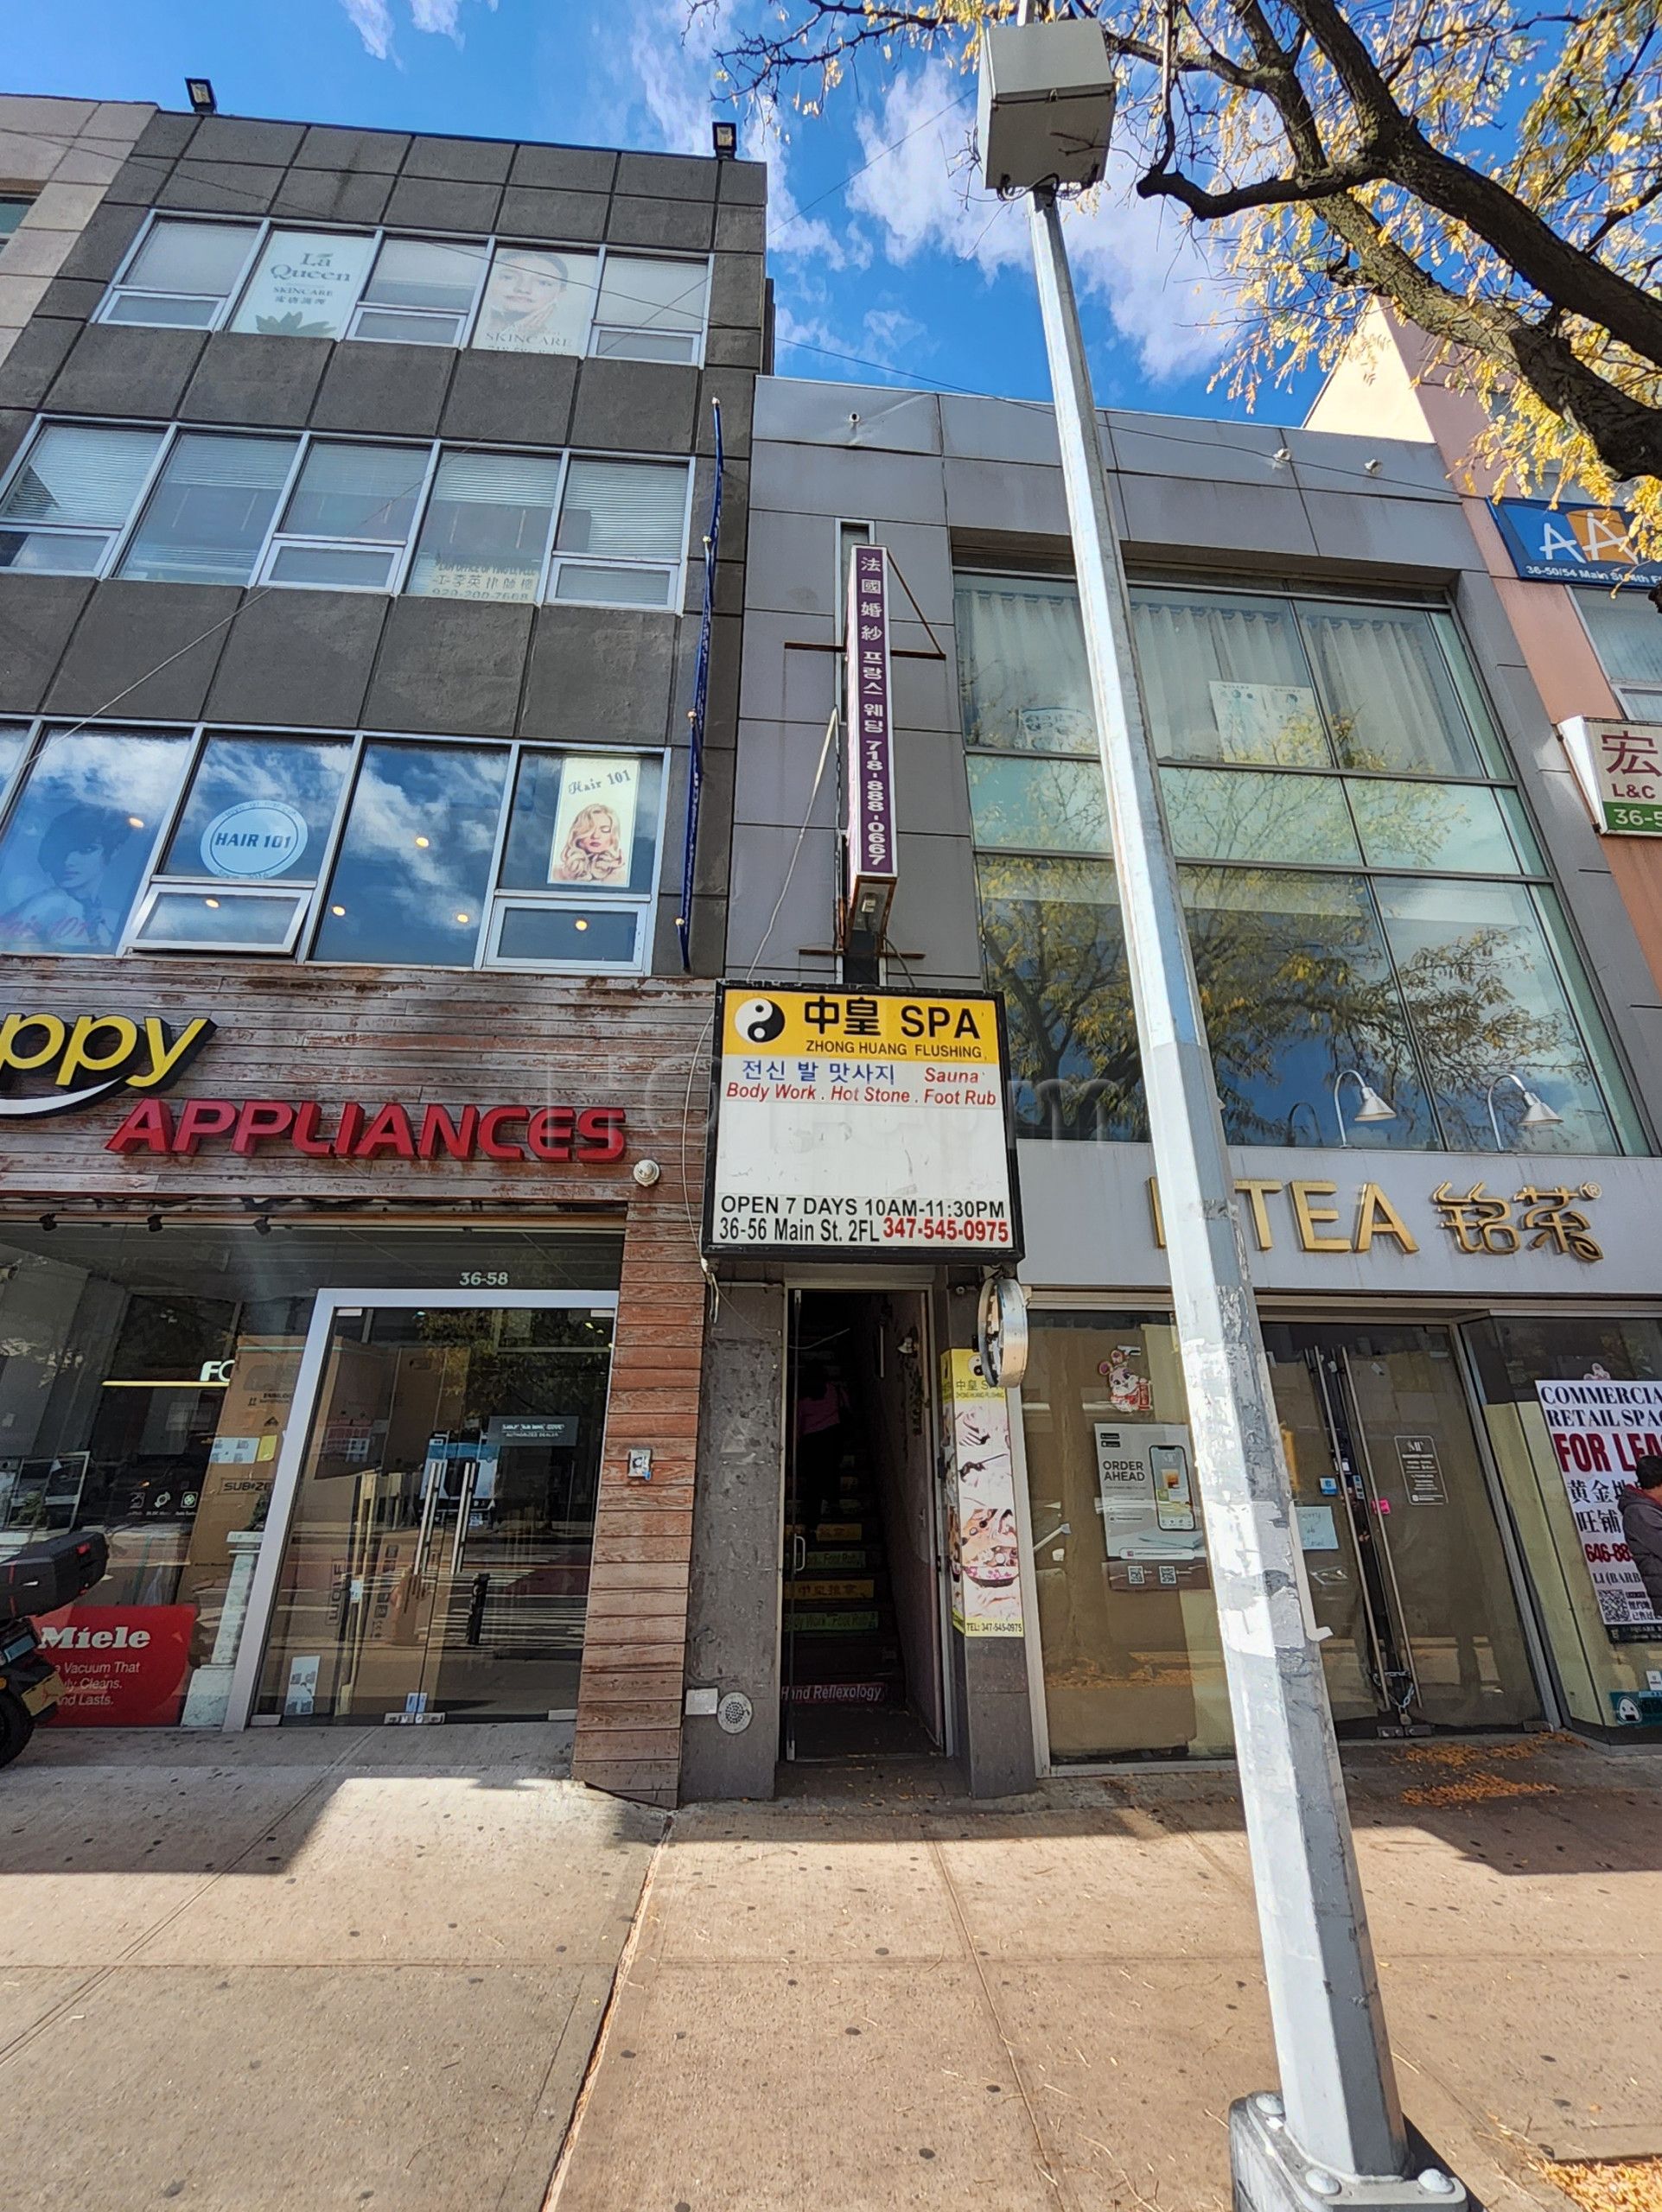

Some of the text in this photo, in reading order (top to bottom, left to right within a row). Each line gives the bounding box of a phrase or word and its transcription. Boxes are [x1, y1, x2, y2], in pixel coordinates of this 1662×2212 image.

[271, 264, 351, 282] Queen
[273, 286, 334, 296] SKINCARE
[1579, 569, 1608, 580] Main
[860, 556, 882, 641] 法國婚紗
[863, 652, 884, 695] 프랑스
[1602, 730, 1662, 777] 宏
[569, 769, 631, 795] Hair 101
[1611, 783, 1656, 799] L&C
[215, 833, 291, 849] HAIR 101
[804, 995, 980, 1039] 中皇 SPA
[806, 1039, 982, 1058] ZHONG HUANG FLUSHING
[742, 1059, 895, 1085] 전신 발 맛사지
[925, 1066, 978, 1084] Sauna
[726, 1082, 997, 1105] Body Work Hot Stone Foot Rub
[105, 1098, 626, 1162] APPLIANCES
[721, 1196, 1004, 1217] OPEN 7 DAYS 10AM-11:30PM
[720, 1217, 1008, 1243] 36-56 Main St. 2FL 347-545-0975
[459, 1271, 508, 1286] 36-58
[1546, 1409, 1662, 1427] RETAIL SPA
[1552, 1433, 1662, 1472] FOR LEA
[1103, 1460, 1143, 1471] ORDER
[1104, 1471, 1145, 1482] AHEAD
[37, 1626, 150, 1649] Miele
[64, 1662, 111, 1674] Vacuum
[114, 1662, 140, 1673] That
[80, 1677, 122, 1690] Cleans.
[79, 1694, 114, 1706] Lasts.
[813, 1685, 882, 1701] Reflexology
